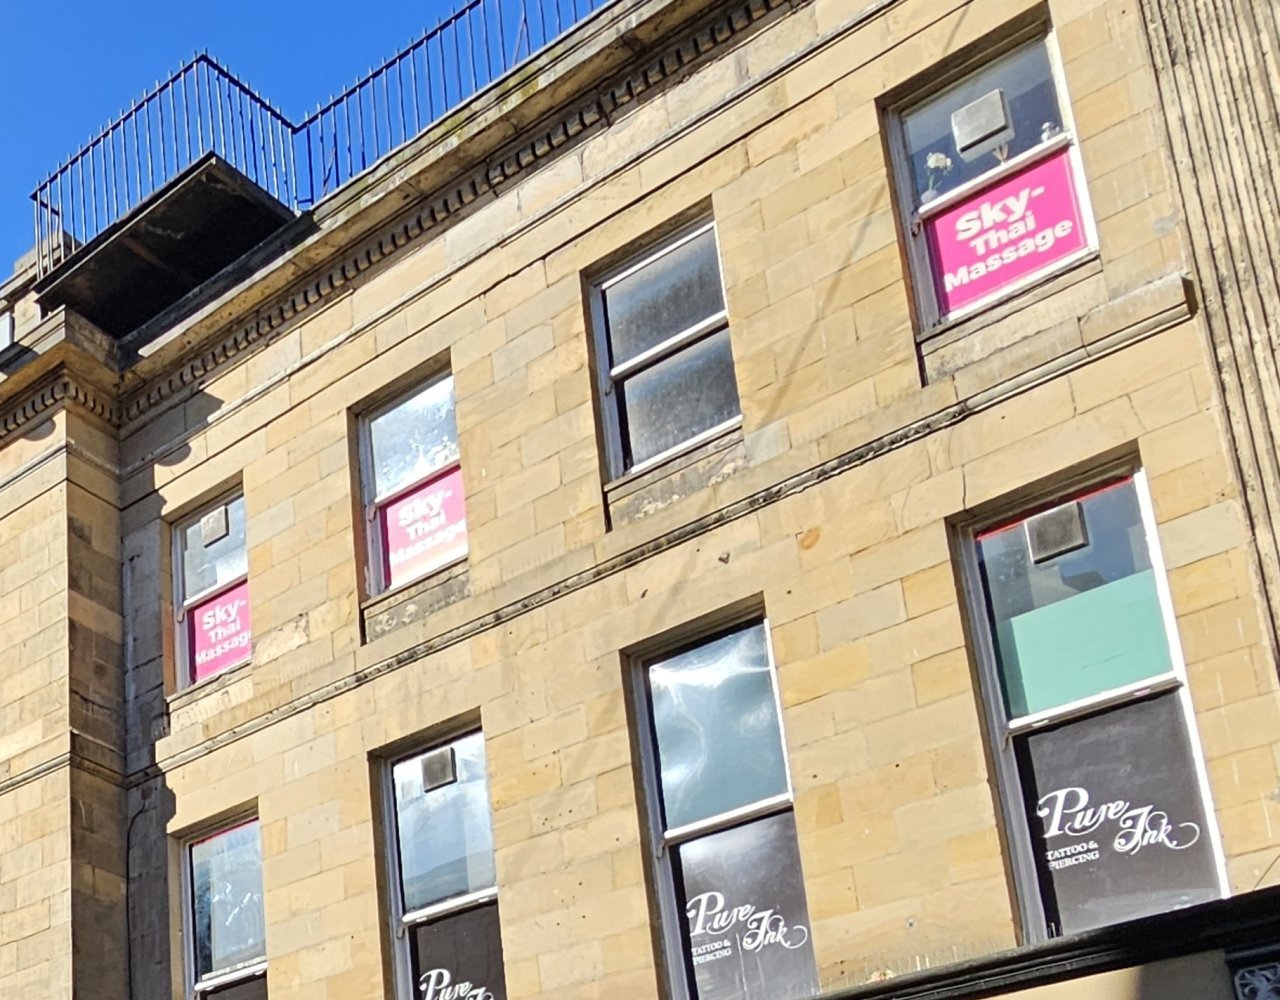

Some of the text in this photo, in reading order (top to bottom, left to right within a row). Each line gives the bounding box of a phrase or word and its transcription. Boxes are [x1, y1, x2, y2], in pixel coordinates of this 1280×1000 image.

[955, 186, 1045, 241] Sky-
[970, 211, 1036, 256] Thai
[944, 219, 1073, 293] Massage
[398, 490, 453, 527] Sky-
[406, 508, 446, 541] Thai
[202, 599, 247, 631] Sky-
[208, 615, 240, 644] Thai
[1036, 787, 1200, 855] Pure Ink
[1047, 840, 1099, 860] TATTOO &
[1049, 850, 1100, 870] PIERCING
[686, 891, 808, 952] Pure Ink
[692, 941, 723, 955] TATTOO
